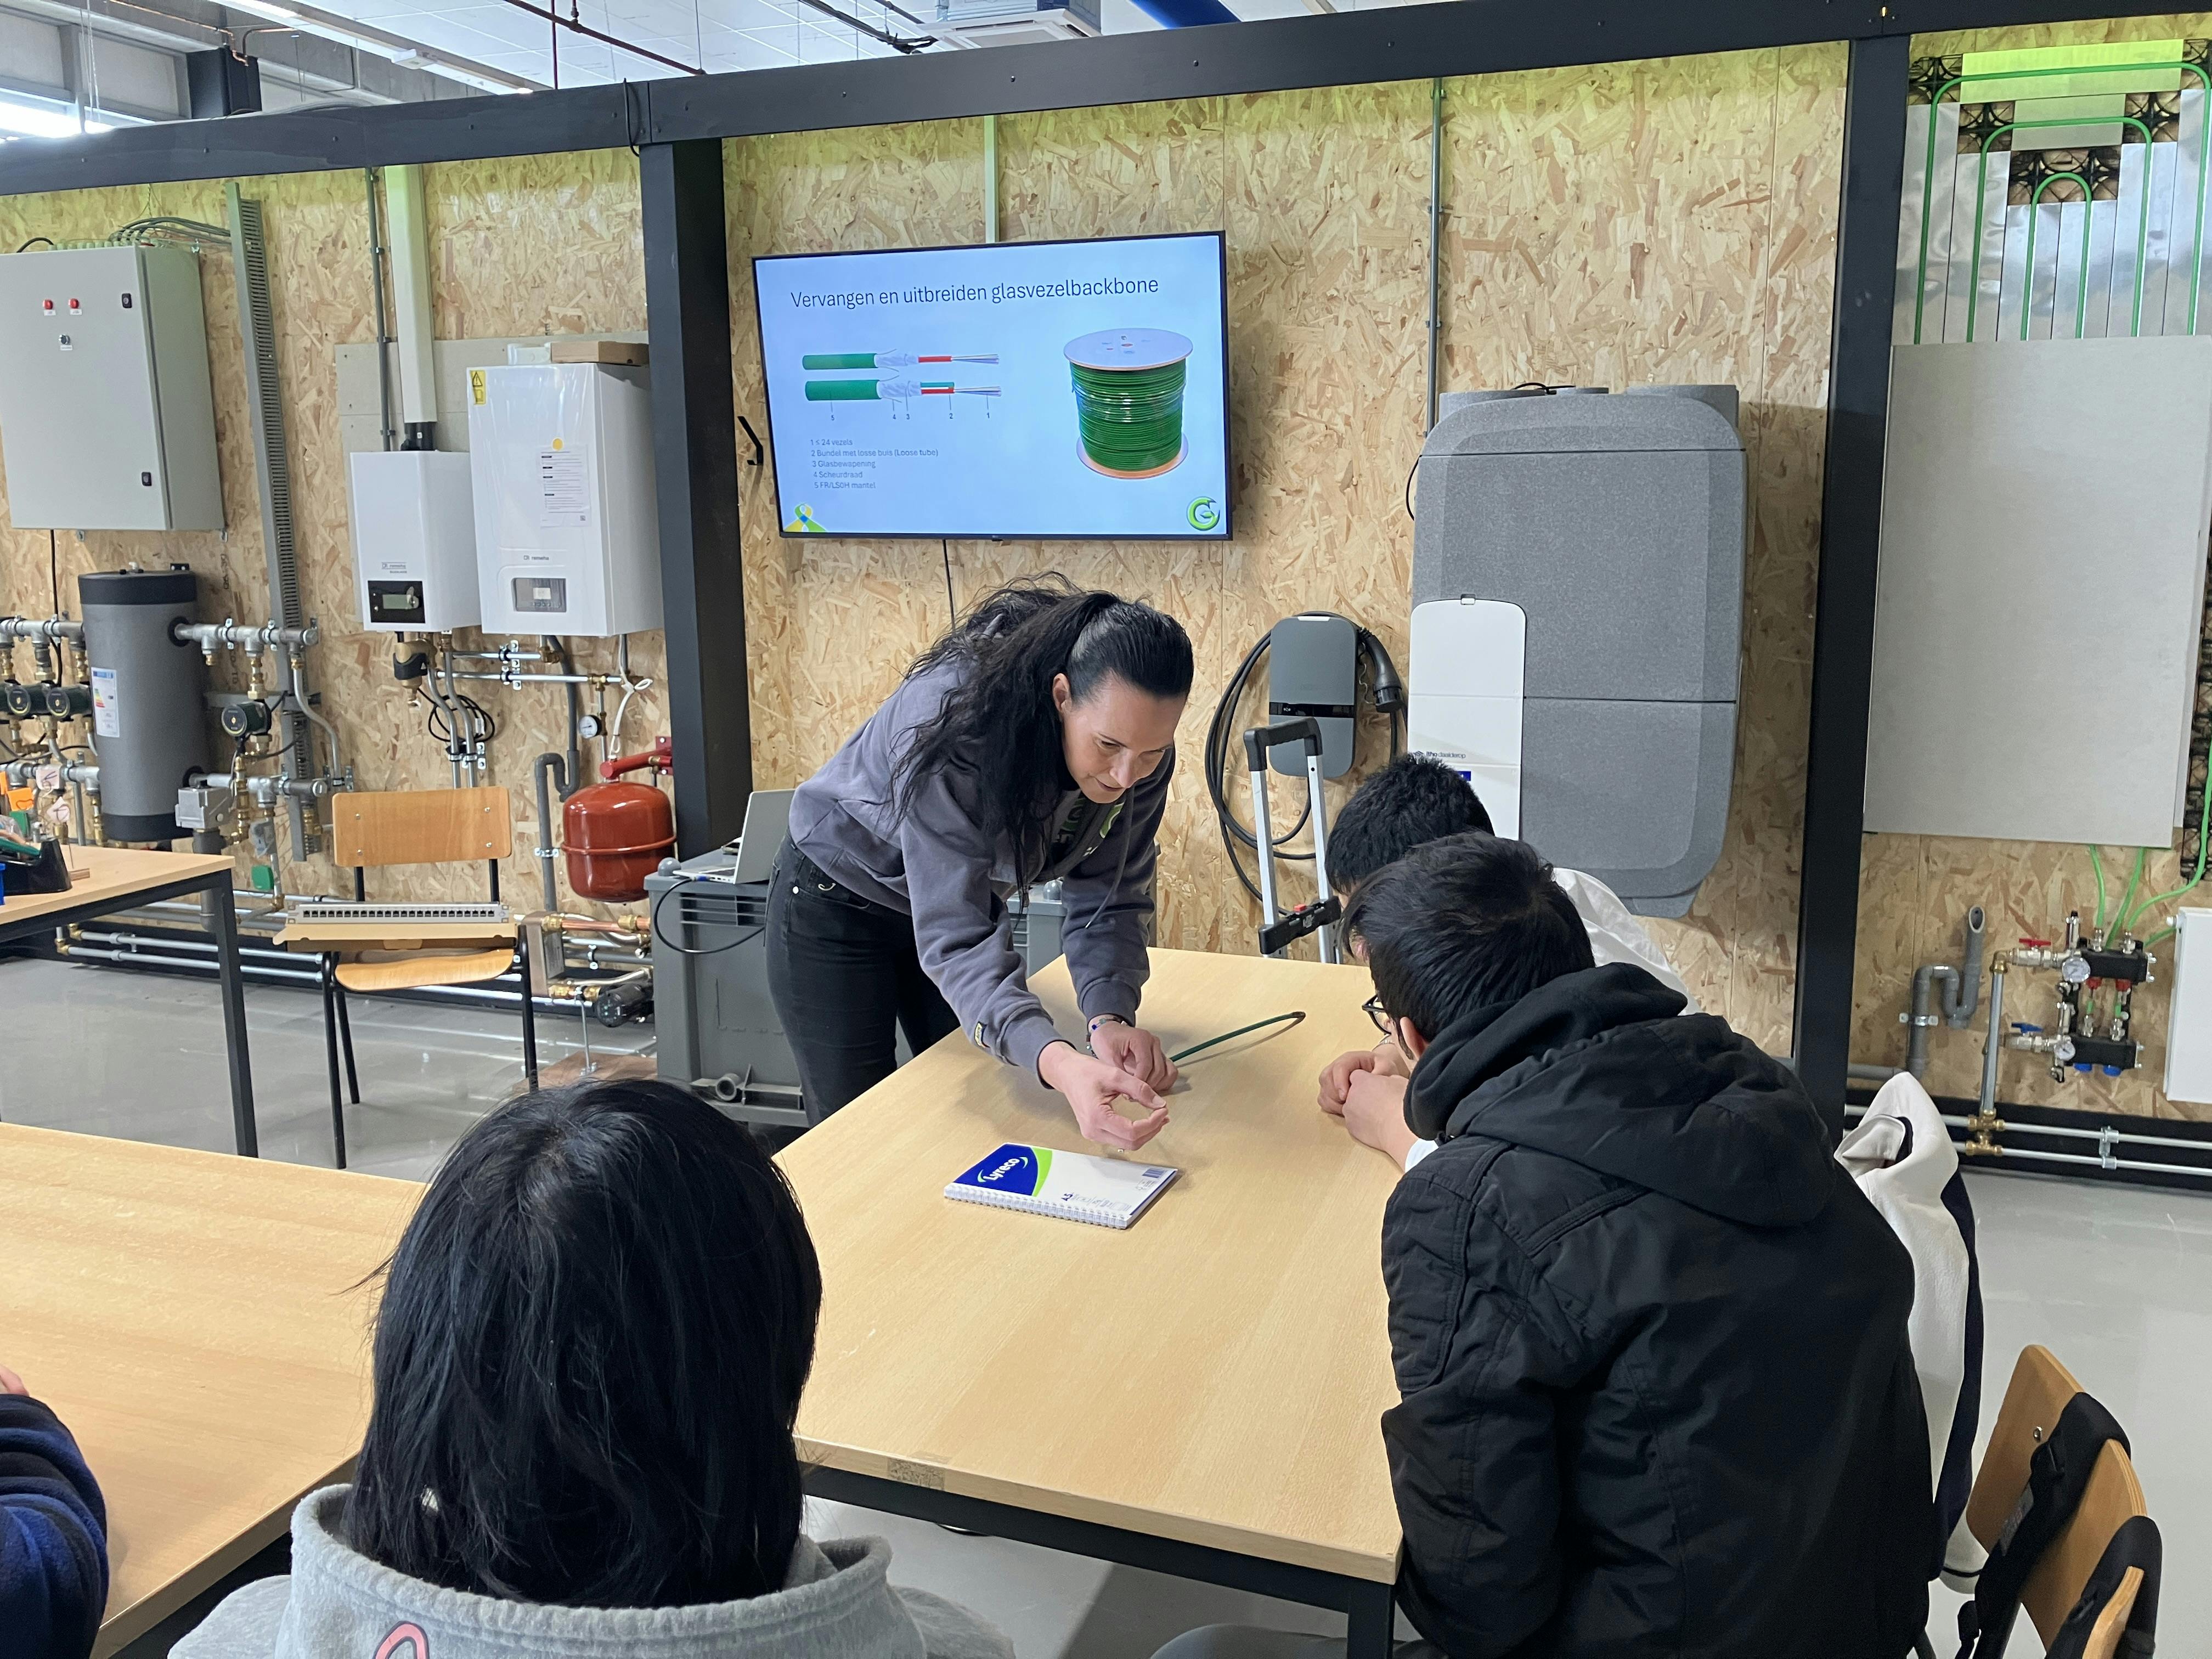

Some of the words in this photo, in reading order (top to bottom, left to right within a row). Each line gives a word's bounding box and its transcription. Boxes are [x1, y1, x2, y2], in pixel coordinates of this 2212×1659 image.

[791, 291, 874, 309] Vervangen
[879, 291, 899, 304] en
[904, 284, 987, 303] uitbreiden
[992, 277, 1159, 304] glasvezelbackbone
[919, 449, 939, 457] tube)
[818, 460, 876, 469] Glasbewapening
[982, 1158, 1020, 1181] Lyreco
